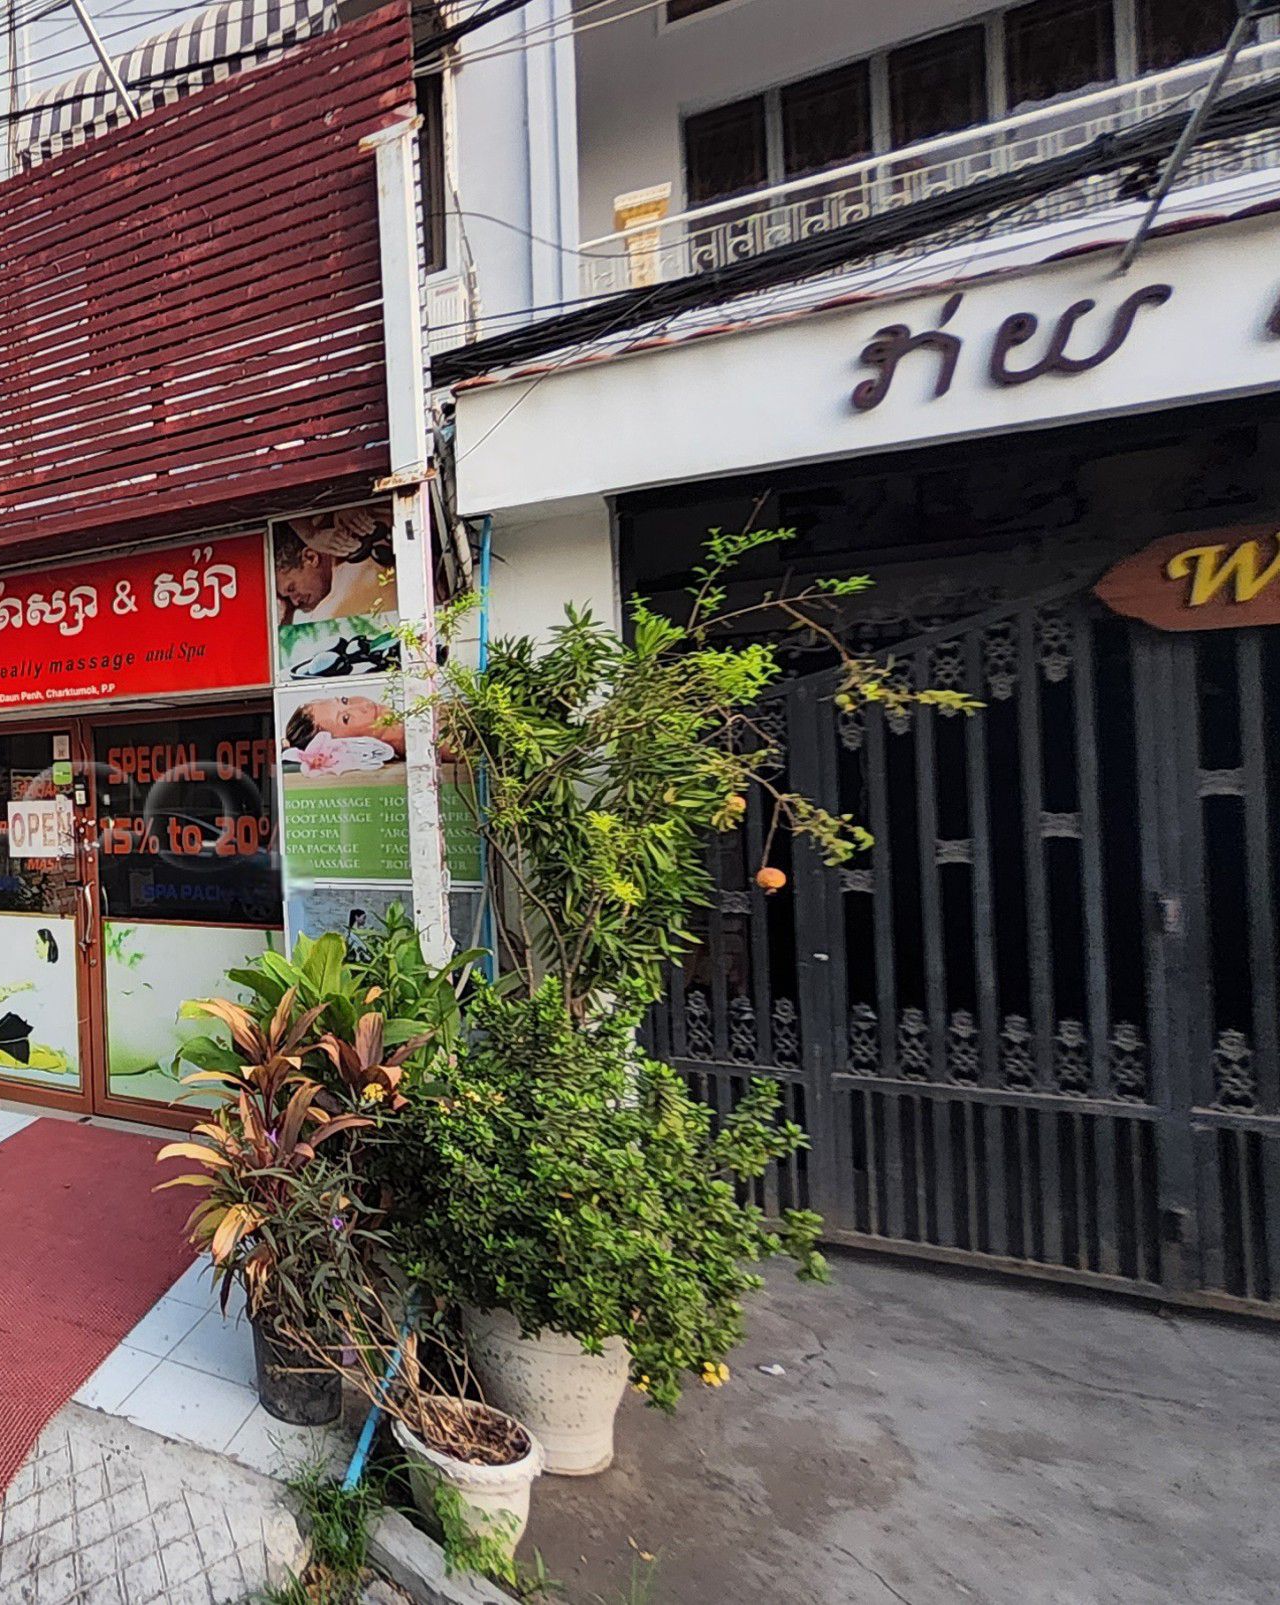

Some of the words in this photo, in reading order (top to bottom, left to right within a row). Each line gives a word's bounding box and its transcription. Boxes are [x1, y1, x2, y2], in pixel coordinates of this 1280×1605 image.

[112, 580, 139, 615] &
[49, 653, 135, 675] massage
[145, 643, 175, 662] and
[178, 641, 207, 662] Spa
[0, 693, 20, 703] Daun
[21, 691, 44, 702] Penh,
[108, 743, 206, 784] SPECIAL
[285, 799, 317, 809] BODY
[319, 797, 372, 808] MASSAGE
[319, 813, 373, 823] MASSAGE
[11, 812, 72, 848] OPEN
[100, 816, 160, 855] 15%
[168, 816, 203, 856] to
[287, 830, 318, 838] FOOT
[320, 829, 339, 838] SPA
[287, 844, 305, 853] SPA
[307, 844, 360, 854] PACKAGE
